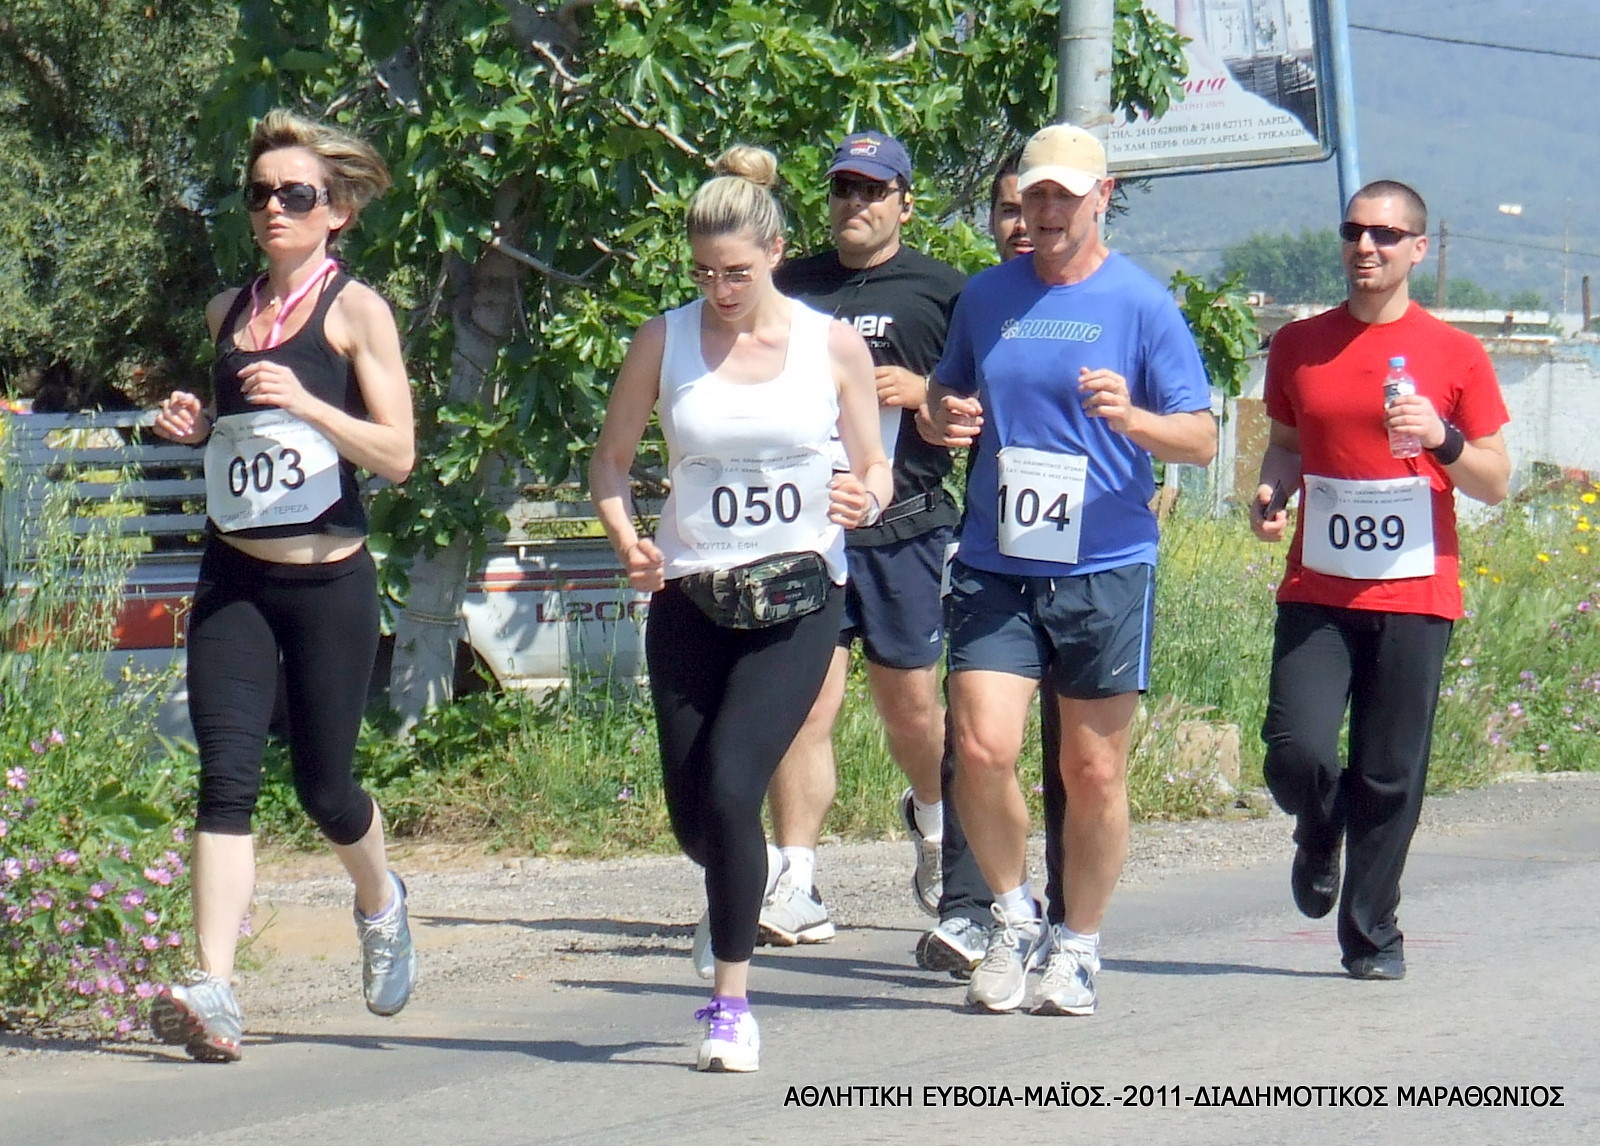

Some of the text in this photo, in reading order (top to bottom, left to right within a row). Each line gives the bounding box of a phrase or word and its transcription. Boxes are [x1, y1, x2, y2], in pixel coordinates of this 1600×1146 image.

[1136, 127, 1156, 137] 2410
[1190, 124, 1198, 132] &
[1200, 122, 1221, 131] 2410
[1223, 118, 1252, 129] 627173
[1257, 115, 1293, 127] ΛΑΡΙΣΑ
[1210, 133, 1249, 145] ΛΑΡΙΣΑΣ
[1257, 128, 1305, 141] ΤΡΙΚΑΛΩΝ
[1017, 319, 1103, 343] RUNNING
[229, 448, 305, 497] 003
[273, 504, 309, 515] ΤΕΡΕΖΑ
[712, 482, 801, 528] 050
[998, 485, 1070, 531] 104
[1328, 513, 1405, 552] 089
